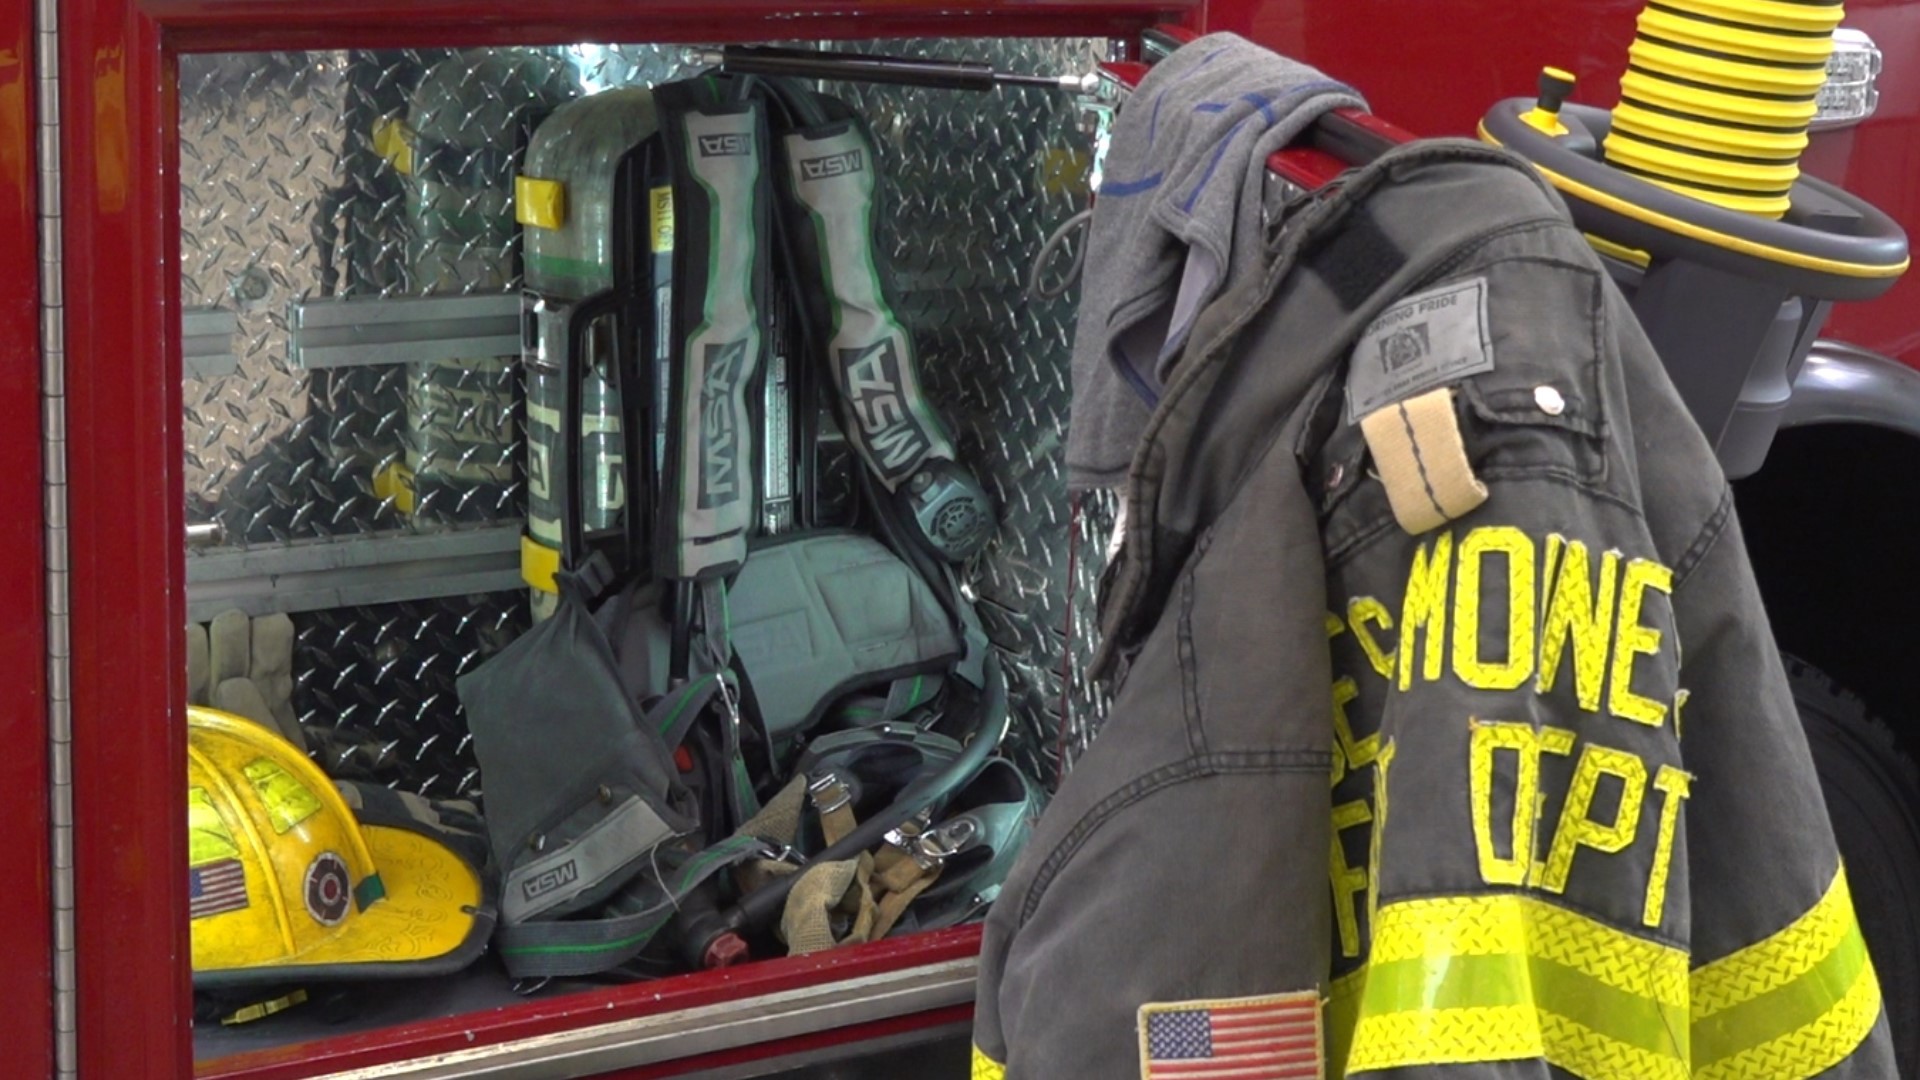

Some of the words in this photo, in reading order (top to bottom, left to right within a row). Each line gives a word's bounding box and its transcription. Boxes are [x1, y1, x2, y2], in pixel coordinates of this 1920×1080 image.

[701, 136, 751, 154] MSA
[803, 151, 861, 178] MSA
[1418, 294, 1458, 315] PRIDE
[703, 345, 742, 495] MSA
[846, 342, 922, 470] MSA
[524, 862, 575, 898] MSA
